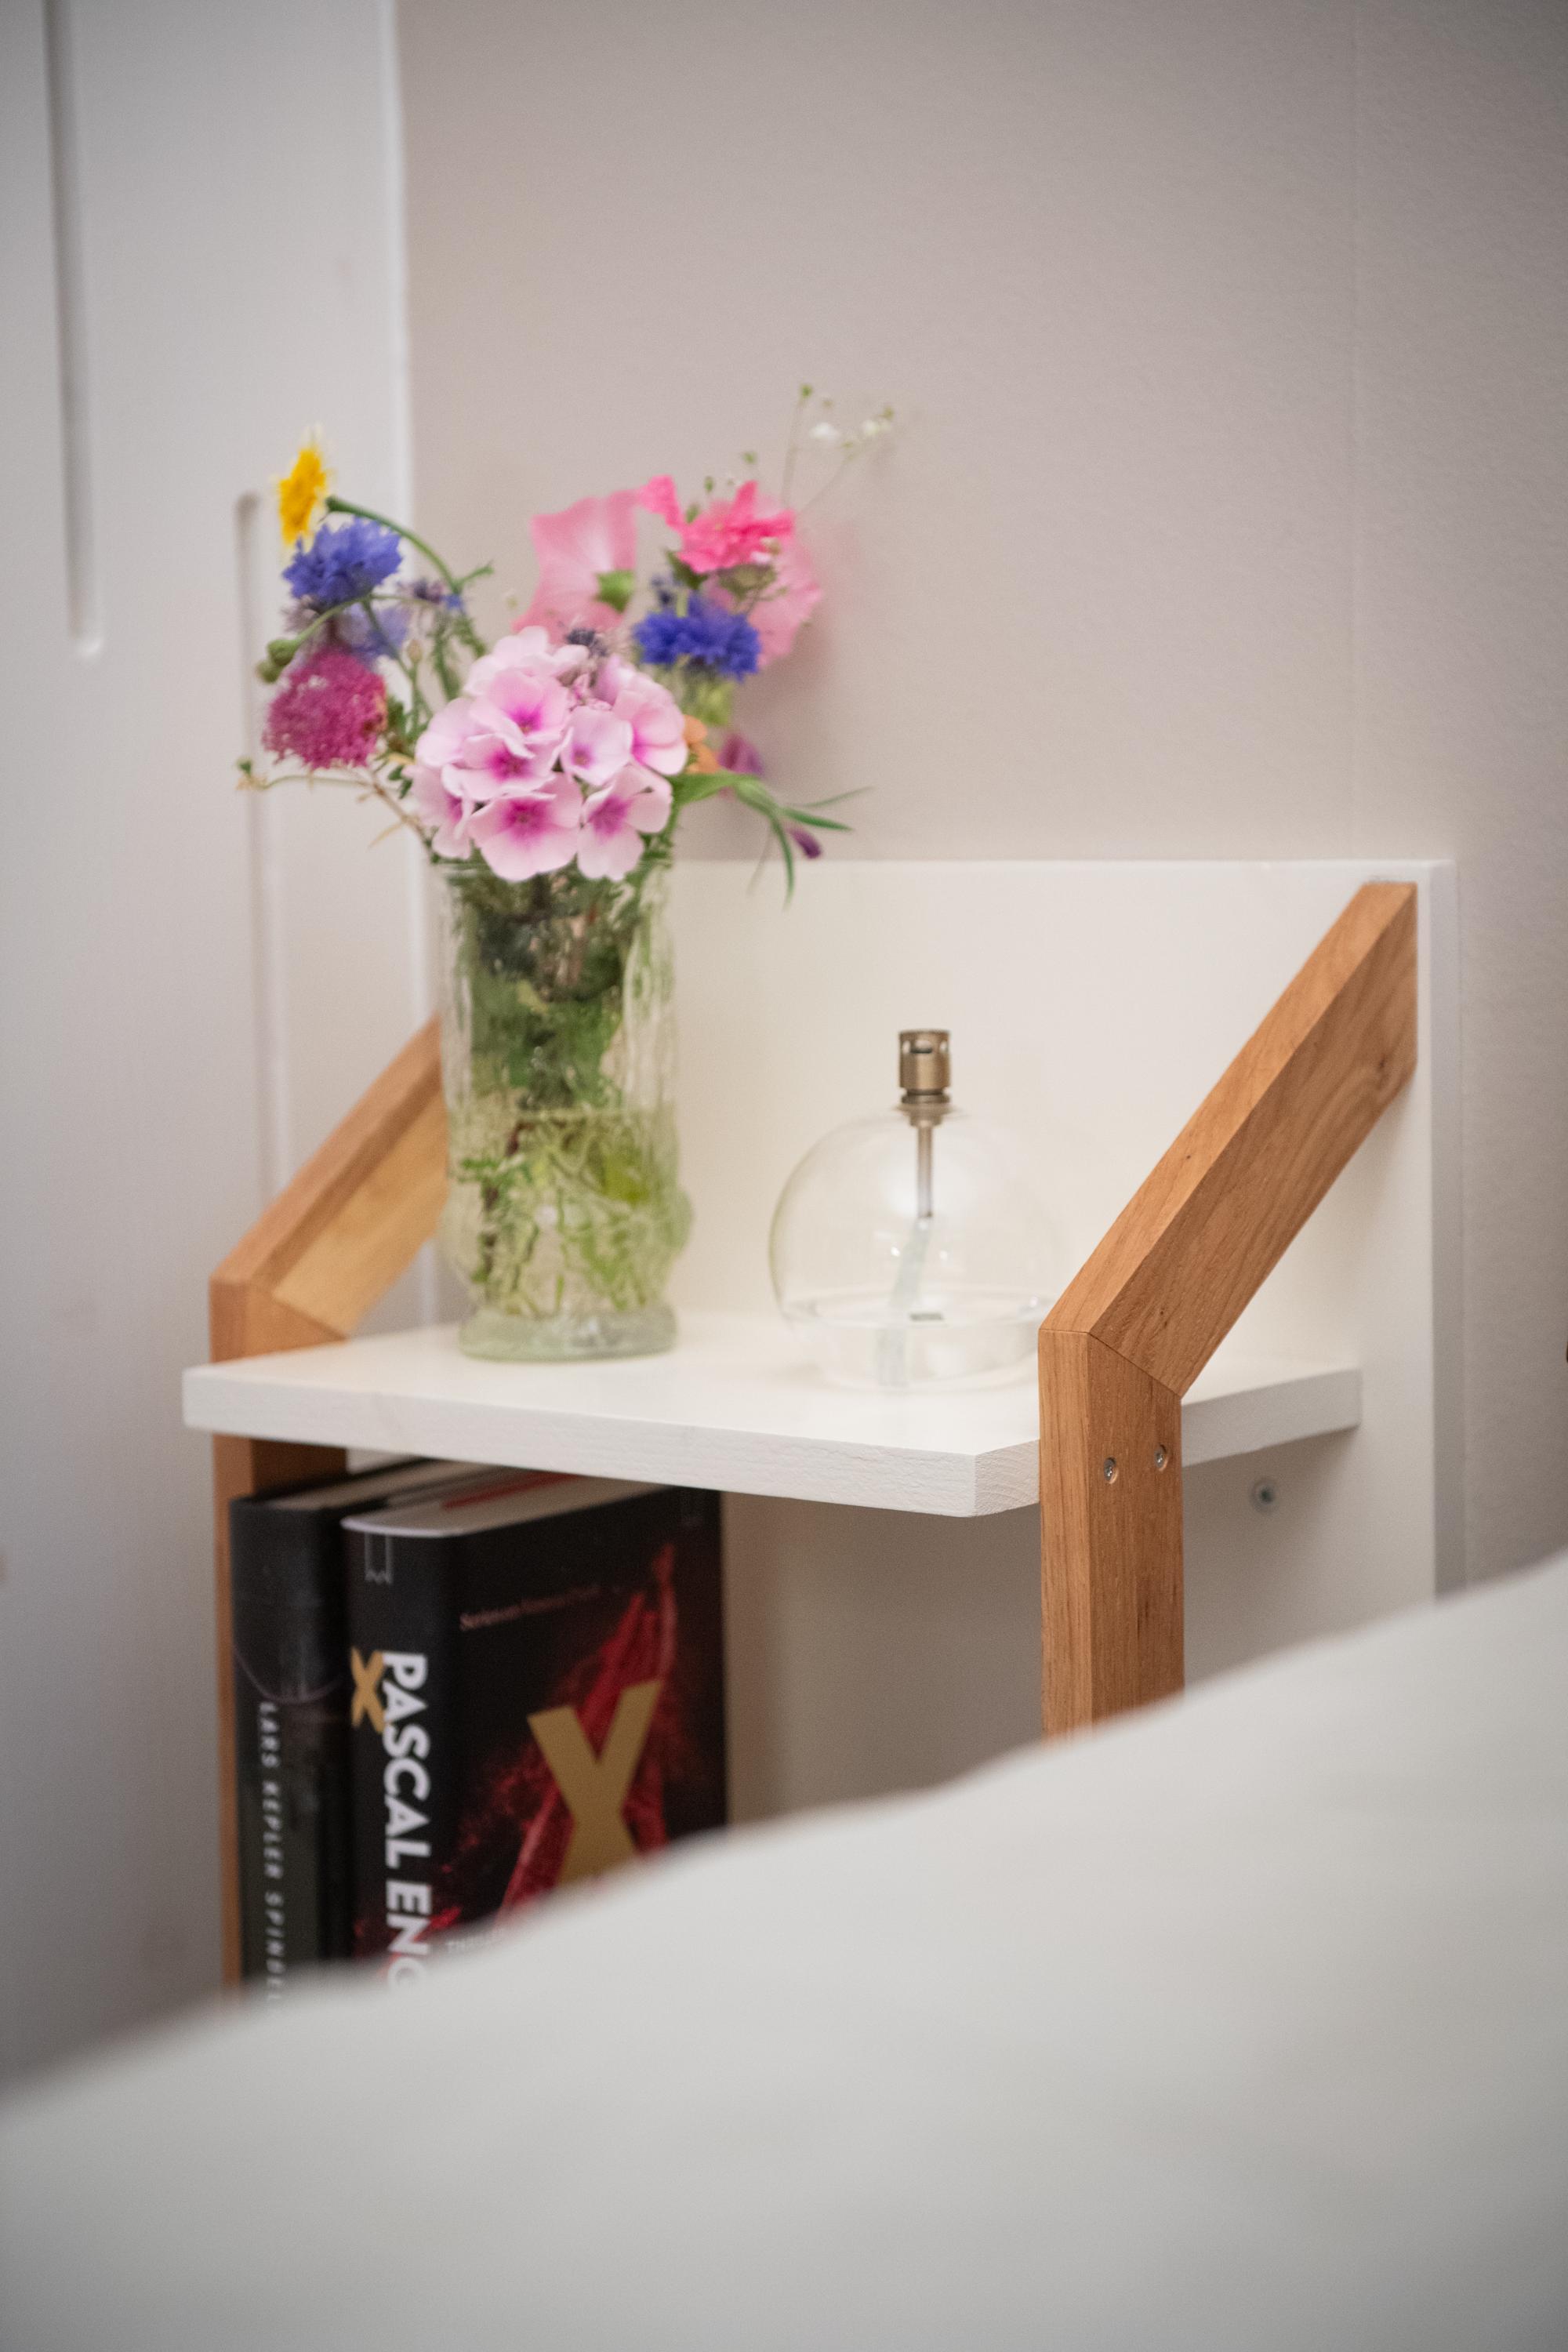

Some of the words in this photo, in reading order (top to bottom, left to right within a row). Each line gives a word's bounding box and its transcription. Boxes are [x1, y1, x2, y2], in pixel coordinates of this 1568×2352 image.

[259, 1700, 281, 1768] LARS
[382, 1651, 430, 1870] PASCAL
[262, 1780, 284, 1879] KEPLER
